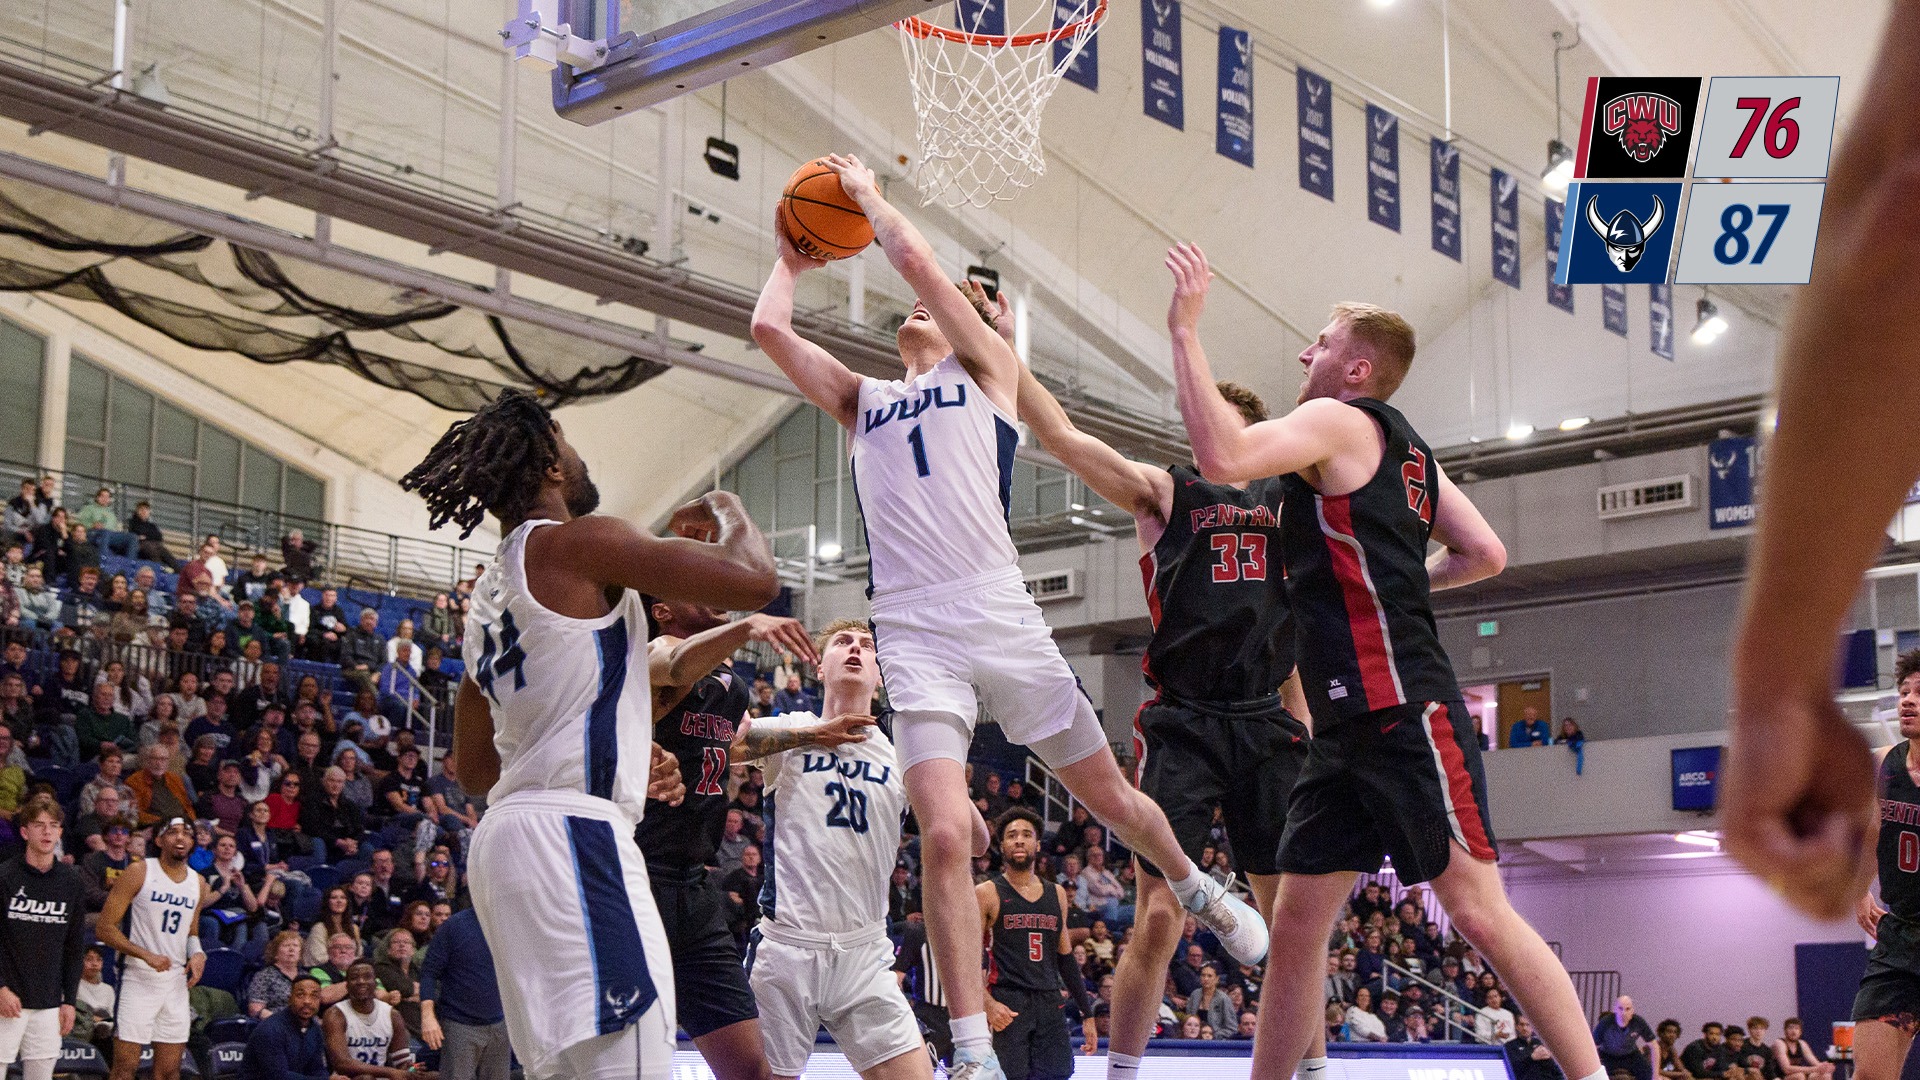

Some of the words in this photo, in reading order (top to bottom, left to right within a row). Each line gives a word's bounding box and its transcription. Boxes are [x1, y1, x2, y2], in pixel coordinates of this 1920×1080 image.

[864, 384, 966, 434] WWU
[907, 423, 931, 478] 1
[1211, 533, 1266, 583] 33
[1330, 679, 1342, 687] XL
[803, 752, 890, 785] WWU
[825, 782, 869, 834] 20
[1898, 831, 1920, 873] 0
[151, 891, 195, 909] WWU
[7, 911, 68, 924] BASKETBALL
[161, 909, 182, 935] 13
[1028, 932, 1043, 962] 5
[348, 1036, 389, 1047] WWU
